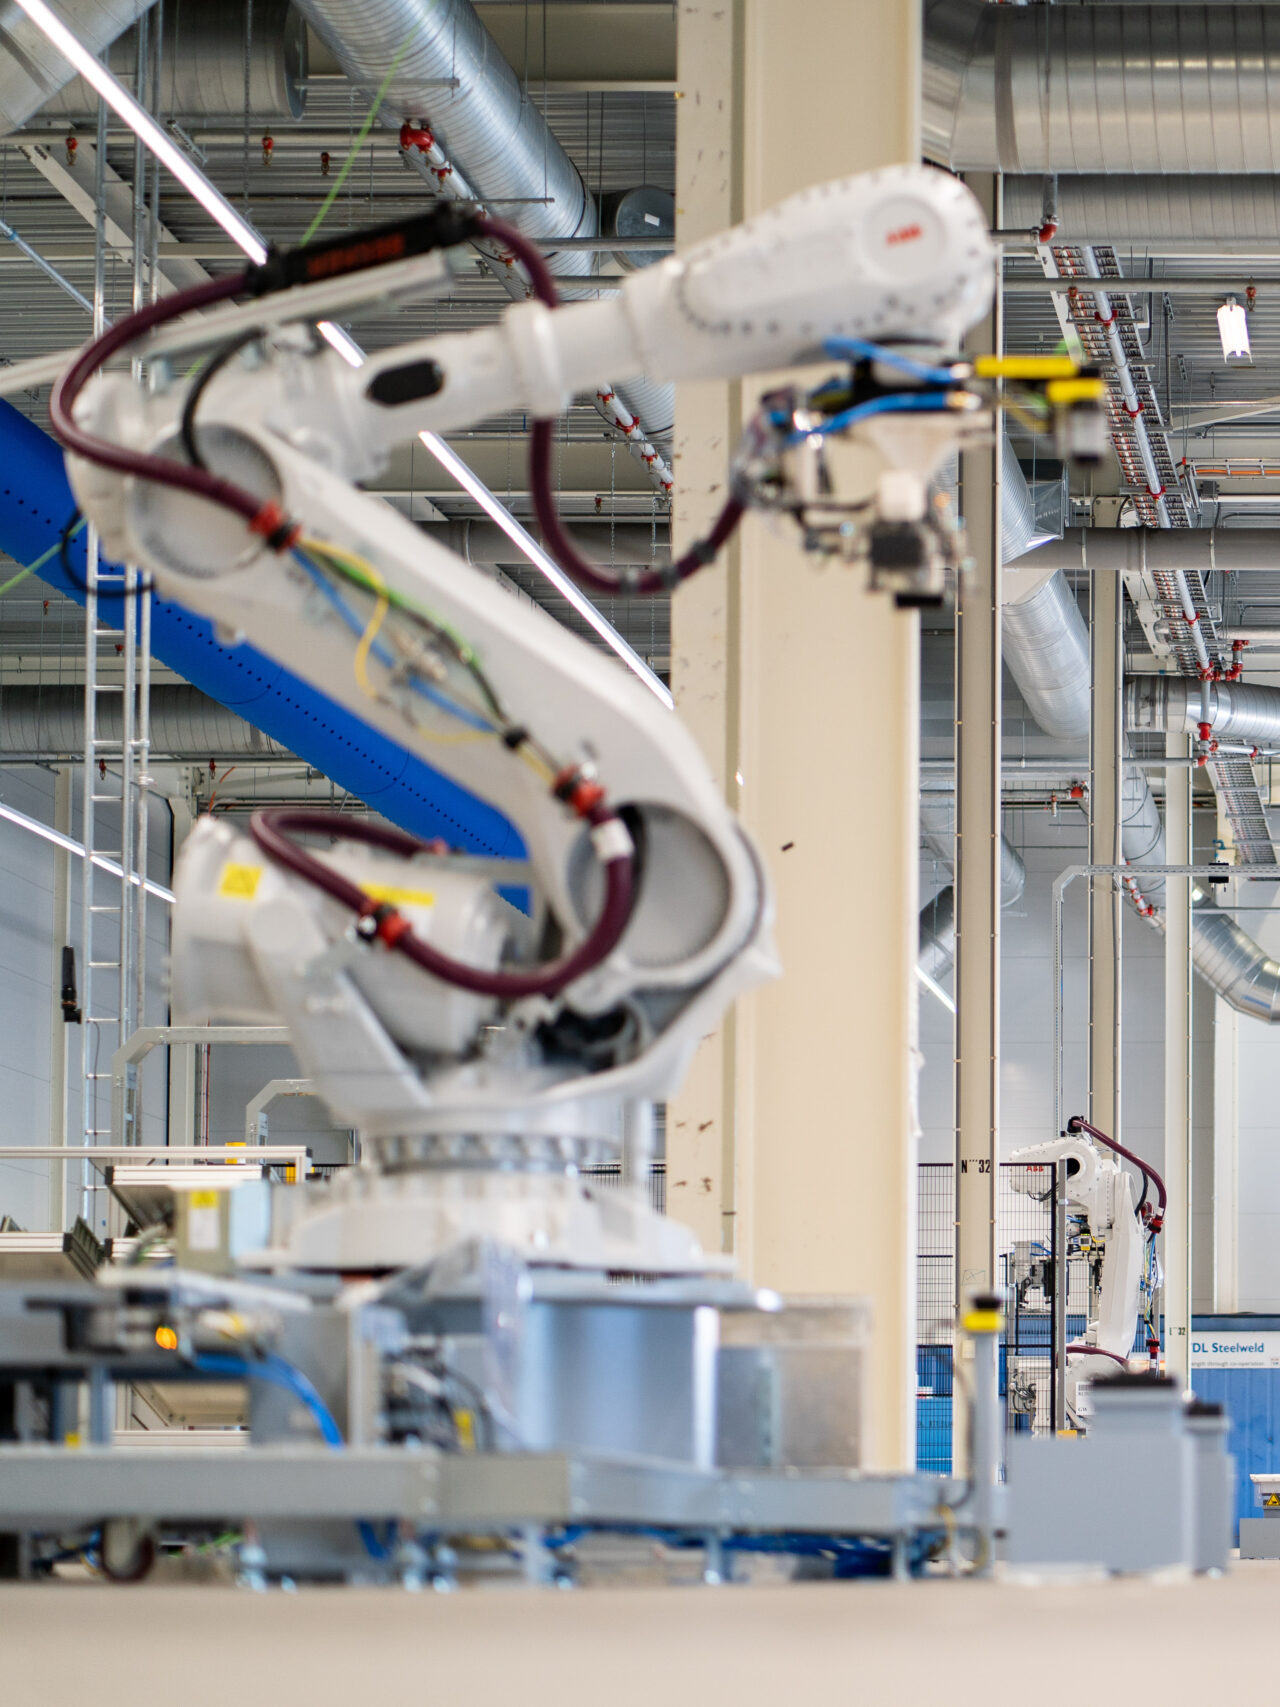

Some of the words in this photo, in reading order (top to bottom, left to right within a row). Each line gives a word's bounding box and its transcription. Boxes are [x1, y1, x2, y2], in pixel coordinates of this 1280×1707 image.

[1026, 1165, 1044, 1173] ABB
[1191, 1342, 1208, 1353] DL
[1211, 1342, 1264, 1353] Steelweld
